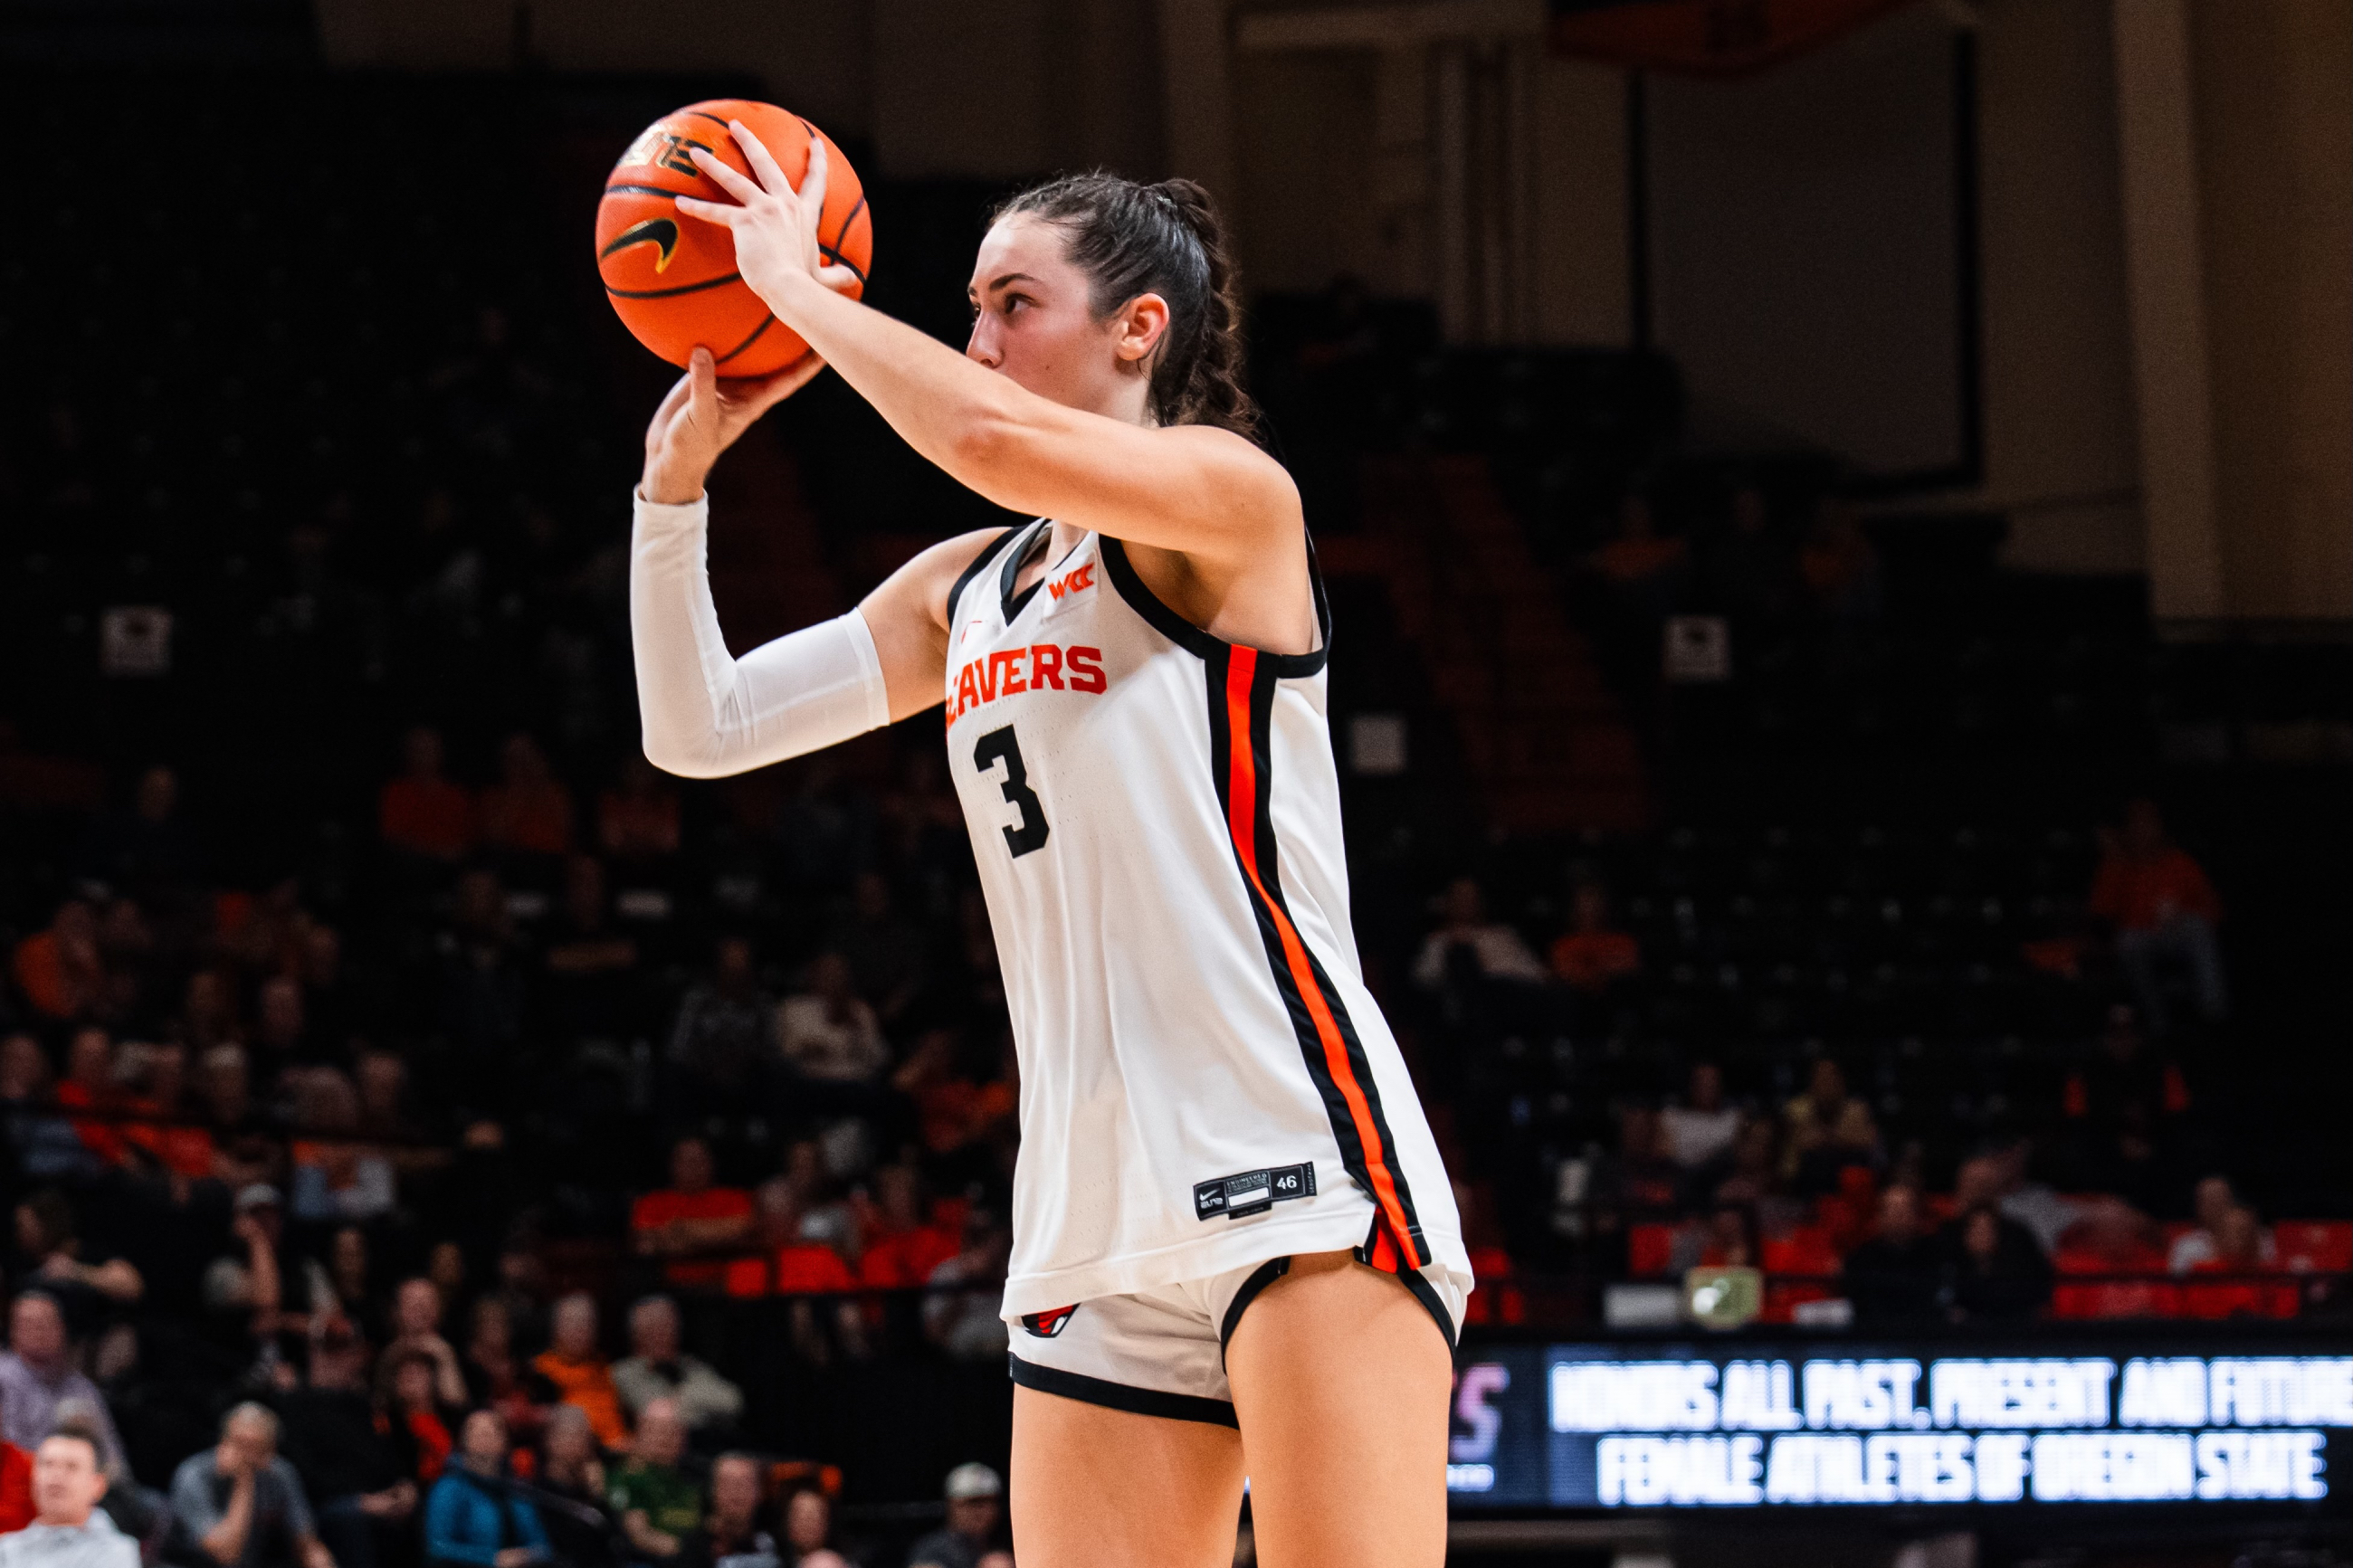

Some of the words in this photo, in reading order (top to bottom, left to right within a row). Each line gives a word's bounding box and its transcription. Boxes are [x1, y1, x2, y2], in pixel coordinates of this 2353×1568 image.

[1048, 562, 1094, 601] WCC
[946, 643, 1108, 731] AVERS
[974, 723, 1050, 859] 3
[1276, 1174, 1298, 1190] 46
[1720, 1359, 1804, 1430] ALL
[1929, 1358, 2118, 1429] PRESENT
[2119, 1357, 2208, 1427] AND
[1596, 1433, 1764, 1506] FEMALE
[1764, 1432, 1974, 1505] ATHLETES
[1974, 1431, 2033, 1503] OF
[2195, 1428, 2329, 1500] STATE
